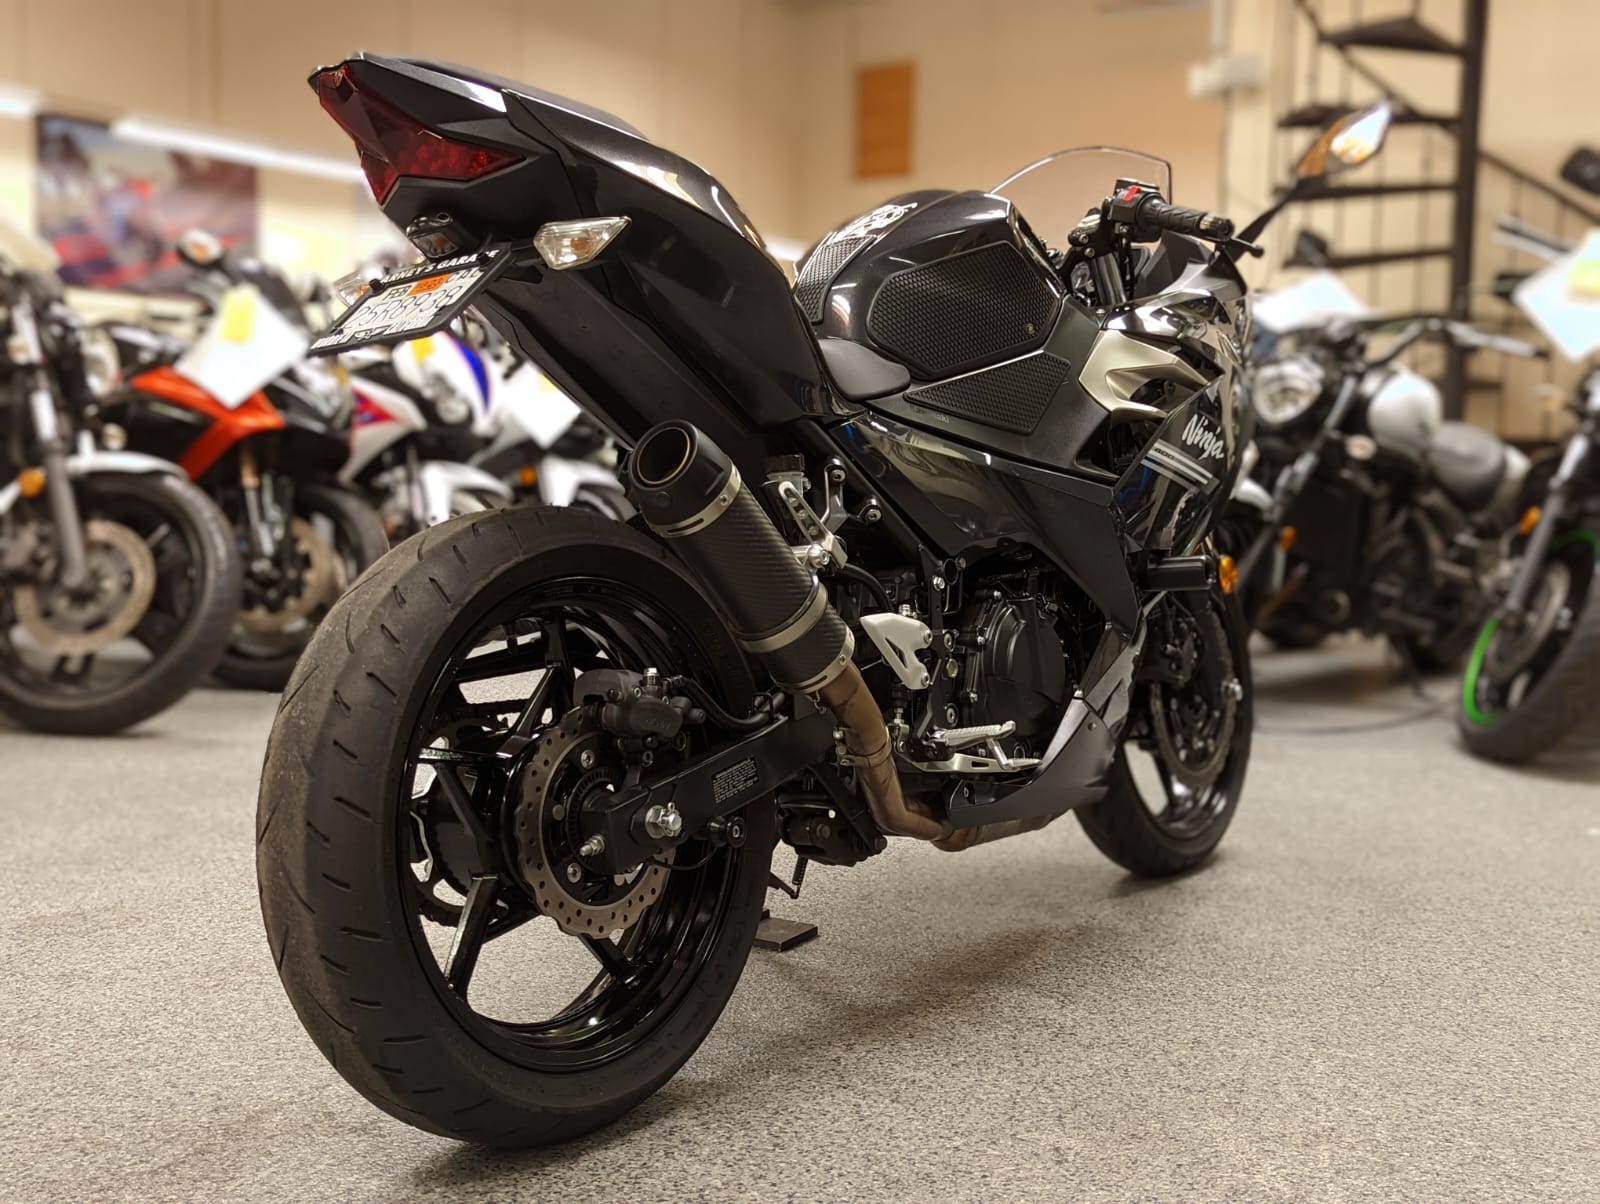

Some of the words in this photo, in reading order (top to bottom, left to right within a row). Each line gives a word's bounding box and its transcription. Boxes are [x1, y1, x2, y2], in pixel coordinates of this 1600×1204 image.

[437, 249, 500, 269] GARAE
[342, 285, 464, 329] 25R8938
[1181, 413, 1224, 460] Ninja
